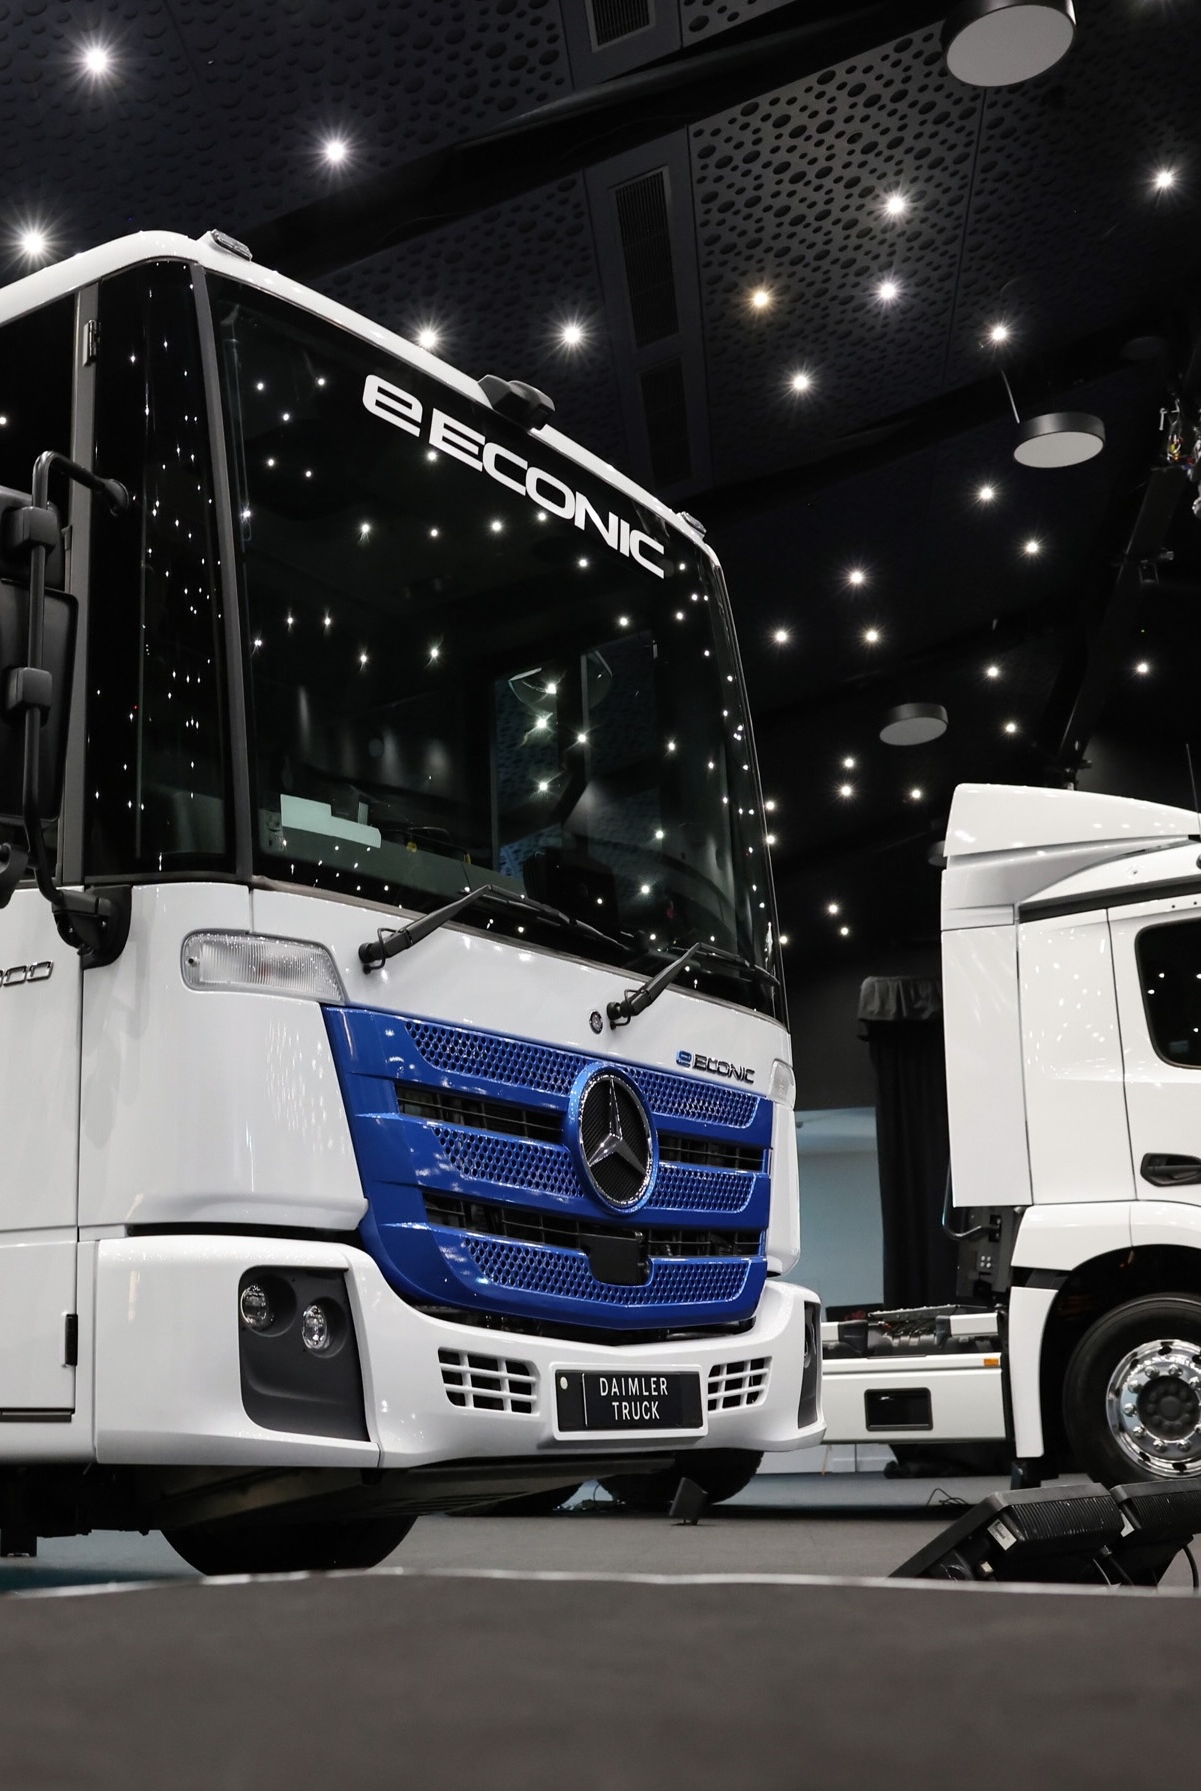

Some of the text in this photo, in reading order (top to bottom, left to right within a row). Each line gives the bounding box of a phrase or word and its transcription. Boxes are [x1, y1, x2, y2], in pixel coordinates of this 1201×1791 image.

[362, 374, 665, 580] e ECONIC
[675, 1049, 755, 1084] e ECONIC
[599, 1376, 668, 1397] DAIMLER
[611, 1400, 660, 1421] TRUCK
